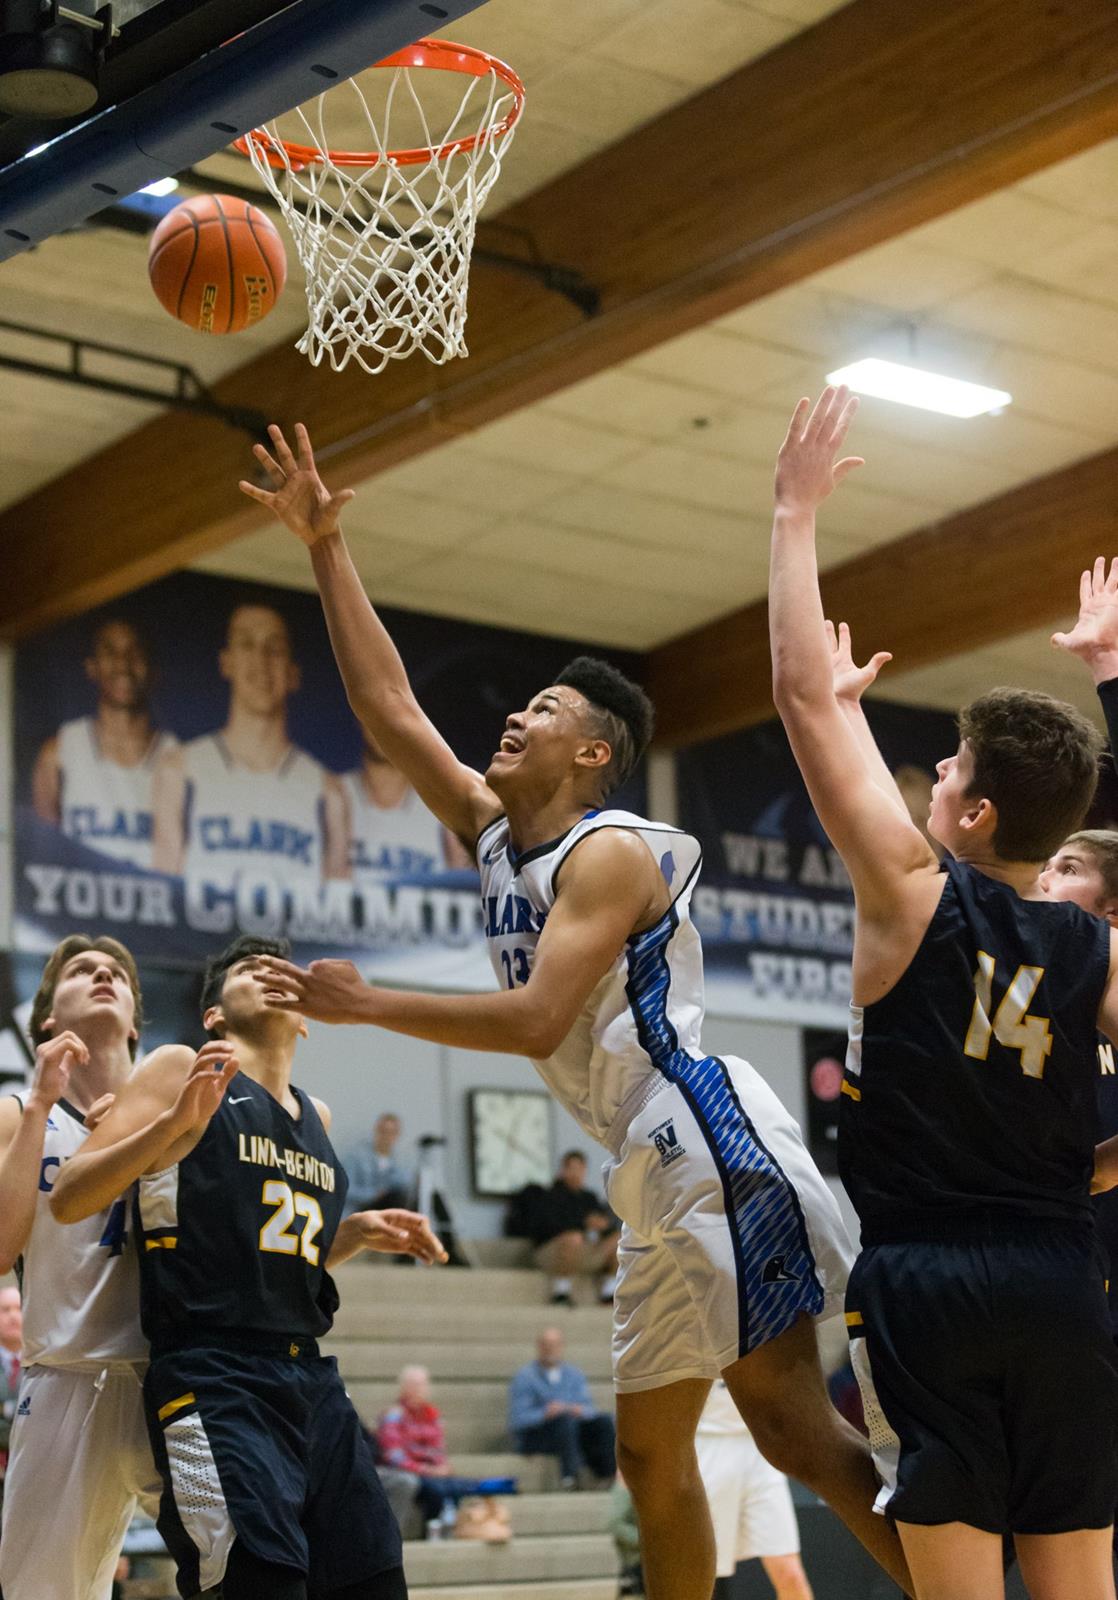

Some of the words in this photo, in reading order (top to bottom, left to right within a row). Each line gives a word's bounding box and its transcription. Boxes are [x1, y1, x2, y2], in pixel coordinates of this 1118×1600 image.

[200, 816, 313, 863] CLARK
[25, 865, 176, 927] YOUR
[964, 950, 1053, 1079] 14
[258, 1179, 323, 1267] 22
